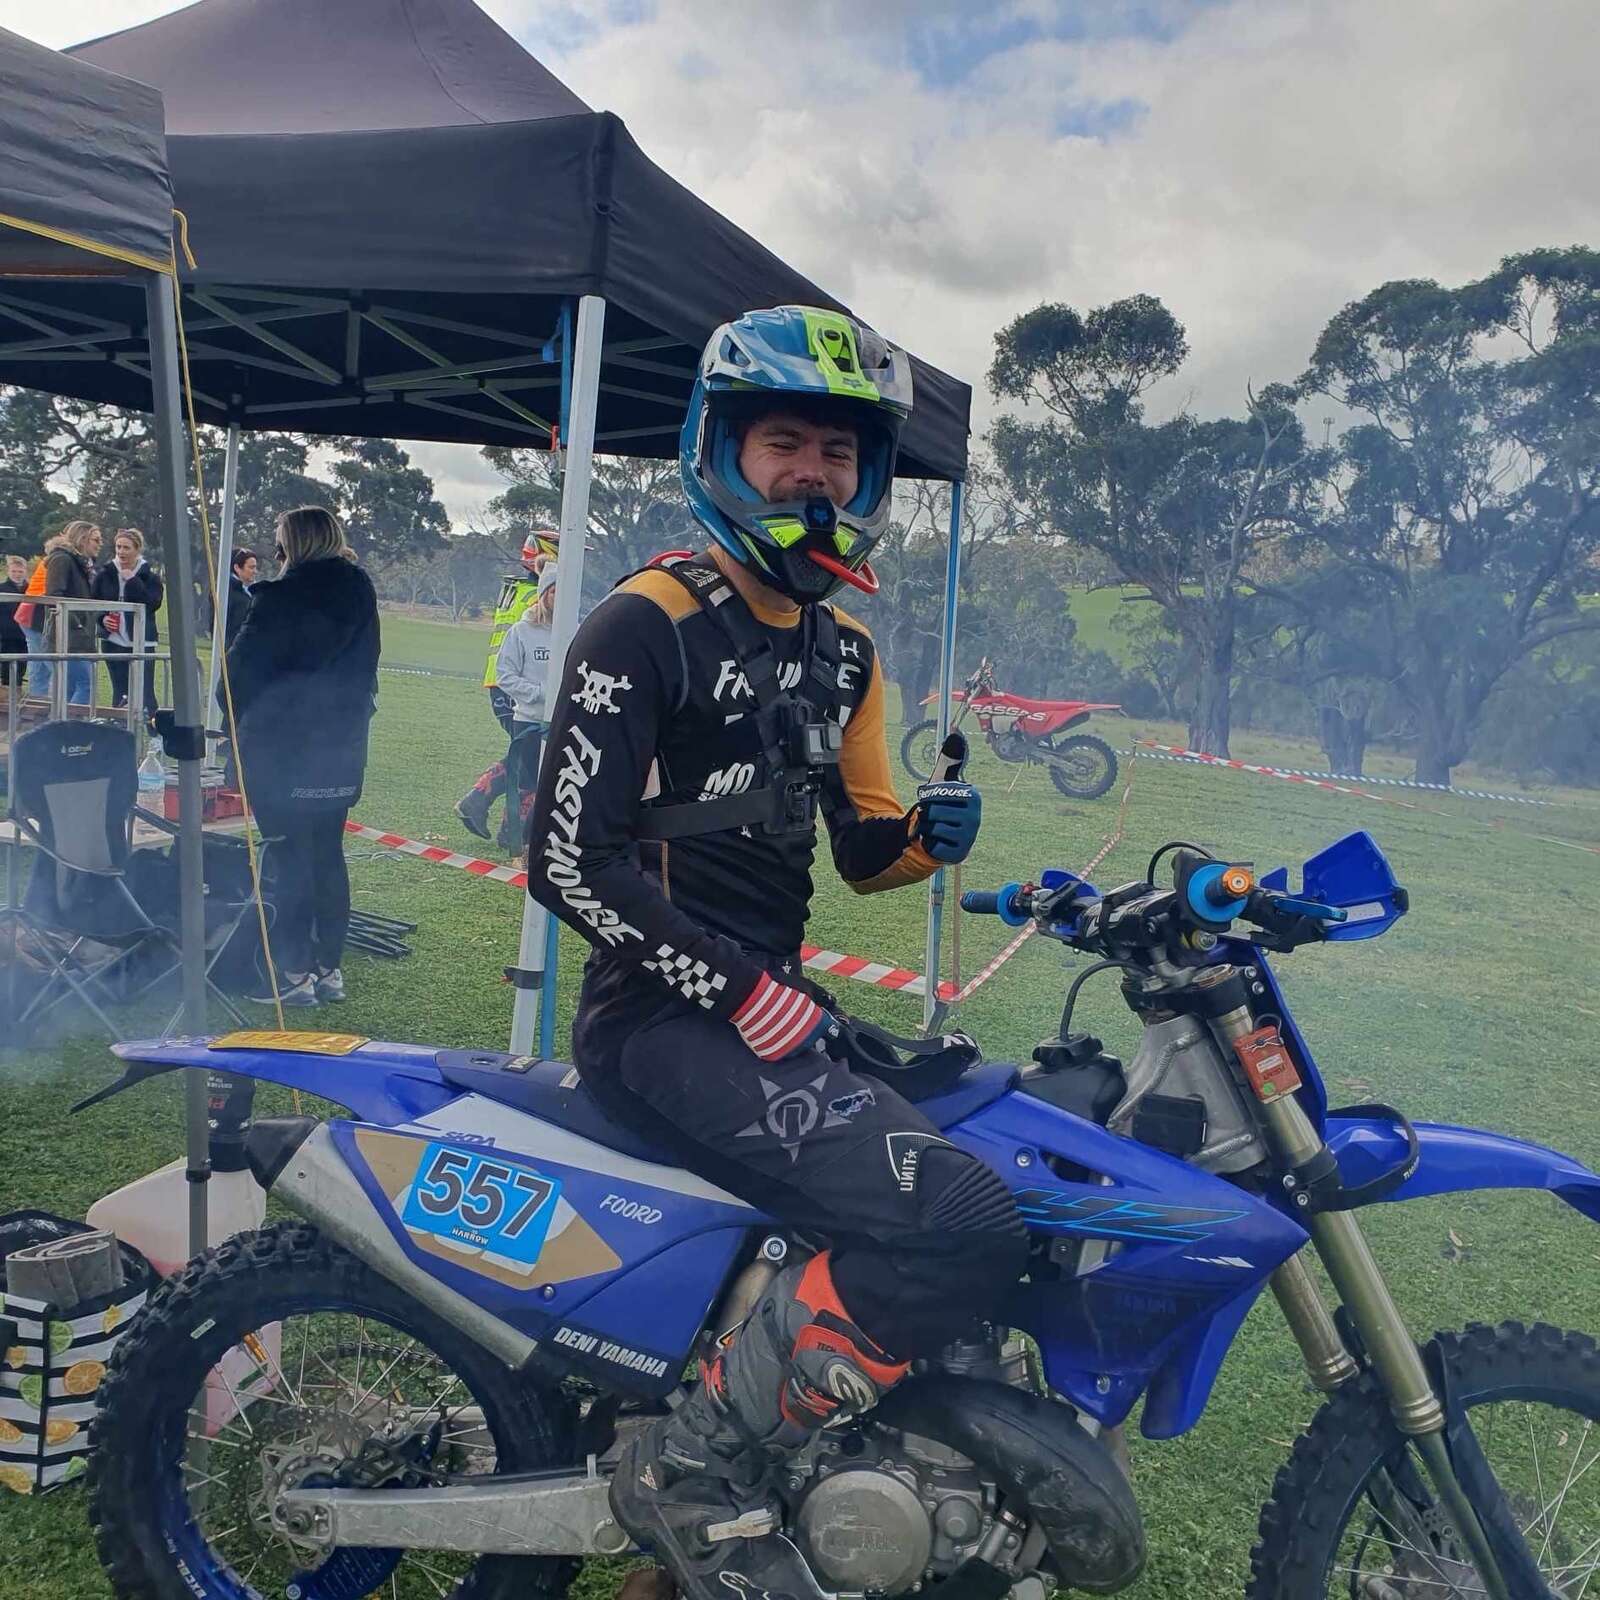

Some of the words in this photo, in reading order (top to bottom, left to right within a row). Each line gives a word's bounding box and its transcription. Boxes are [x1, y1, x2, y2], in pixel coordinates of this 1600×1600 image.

[969, 704, 1048, 721] GASGAS
[544, 725, 645, 947] FASTHOUSE
[900, 1157, 917, 1191] UNIT
[417, 1147, 554, 1239] 557
[599, 1193, 663, 1225] FOORD
[452, 1227, 489, 1245] HARROW
[553, 1327, 597, 1353] DENI
[597, 1341, 669, 1378] YAMAHA
